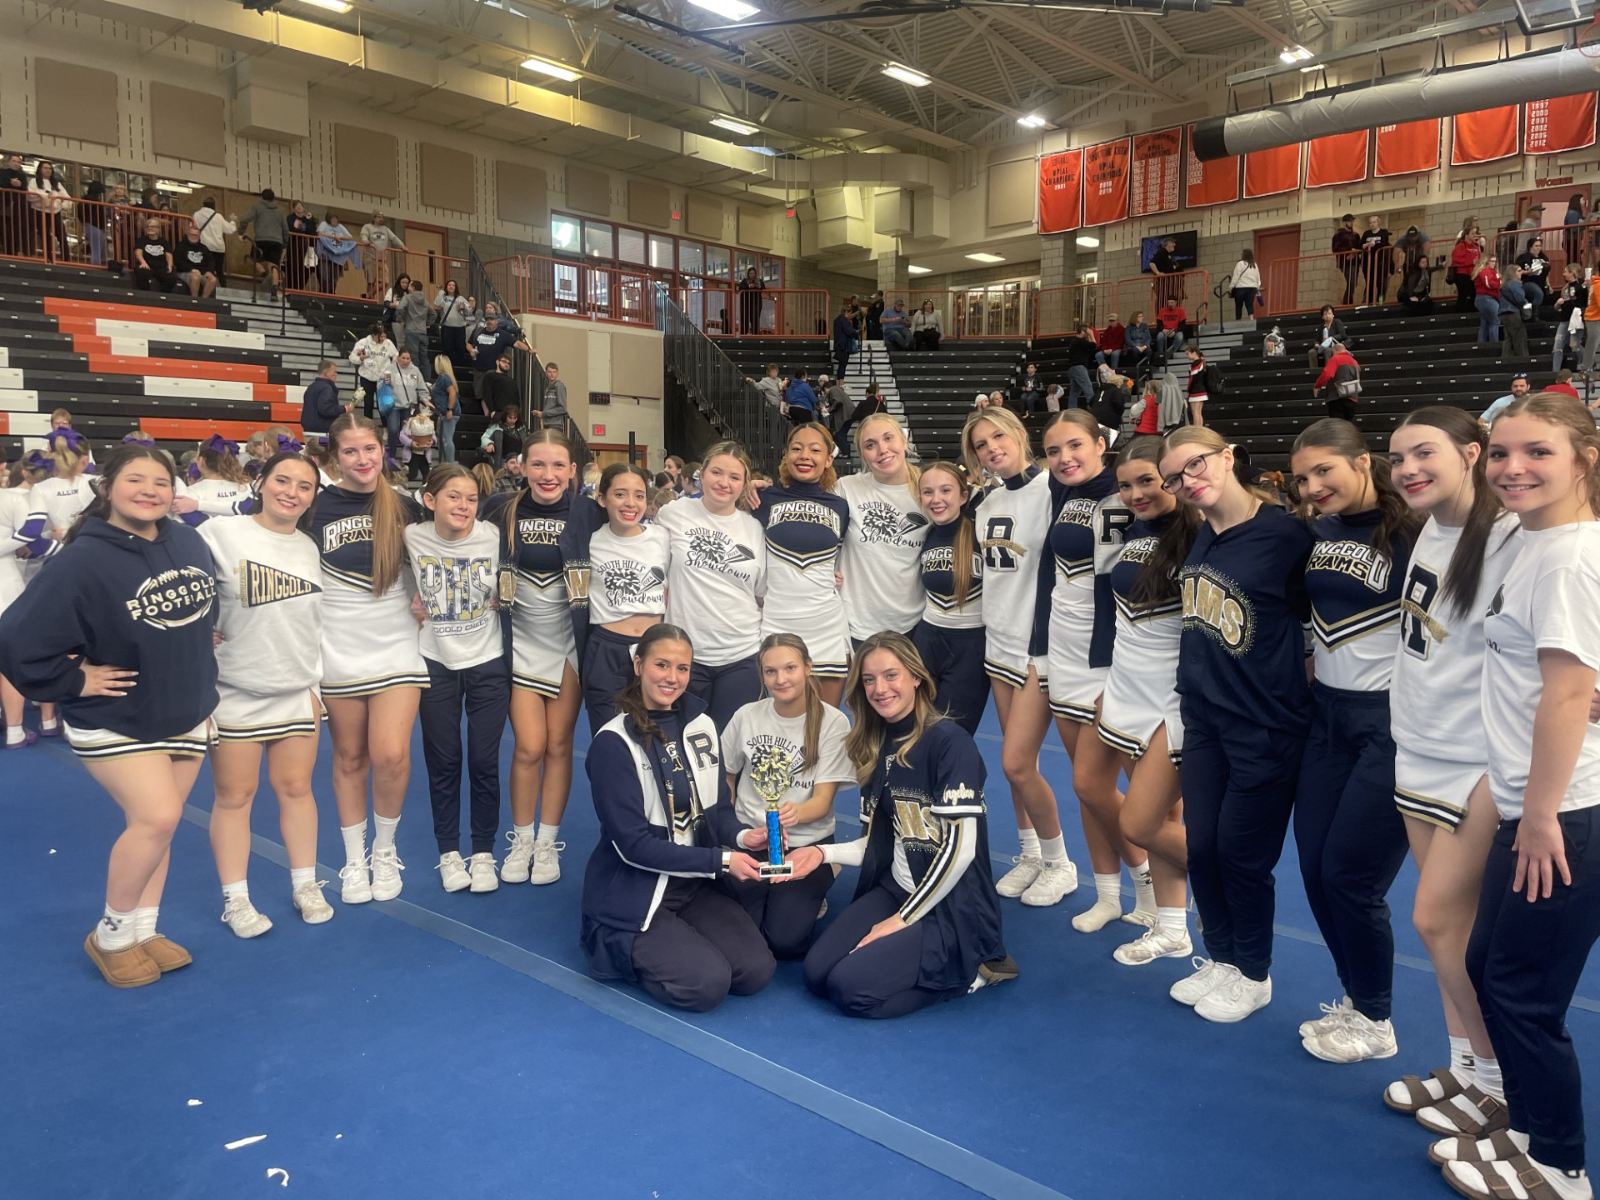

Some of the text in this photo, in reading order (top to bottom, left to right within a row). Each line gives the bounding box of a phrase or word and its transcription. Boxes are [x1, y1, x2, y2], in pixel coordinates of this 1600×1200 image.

[857, 501, 882, 512] SOUTH
[518, 519, 566, 533] INGGO
[684, 527, 734, 546] SOUTH HILLS
[984, 515, 1018, 572] R
[1099, 507, 1136, 545] R
[250, 562, 312, 605] RINGGOLD
[596, 560, 646, 576] SOUTH HILLS
[684, 550, 751, 582] Showdown
[1309, 555, 1369, 580] RAMS
[126, 576, 215, 611] RINGGOLD
[418, 554, 493, 622] RHS
[1182, 576, 1244, 646] AMS
[1400, 561, 1444, 662] R
[685, 729, 719, 772] R
[746, 734, 797, 754] SOUTH HILLS
